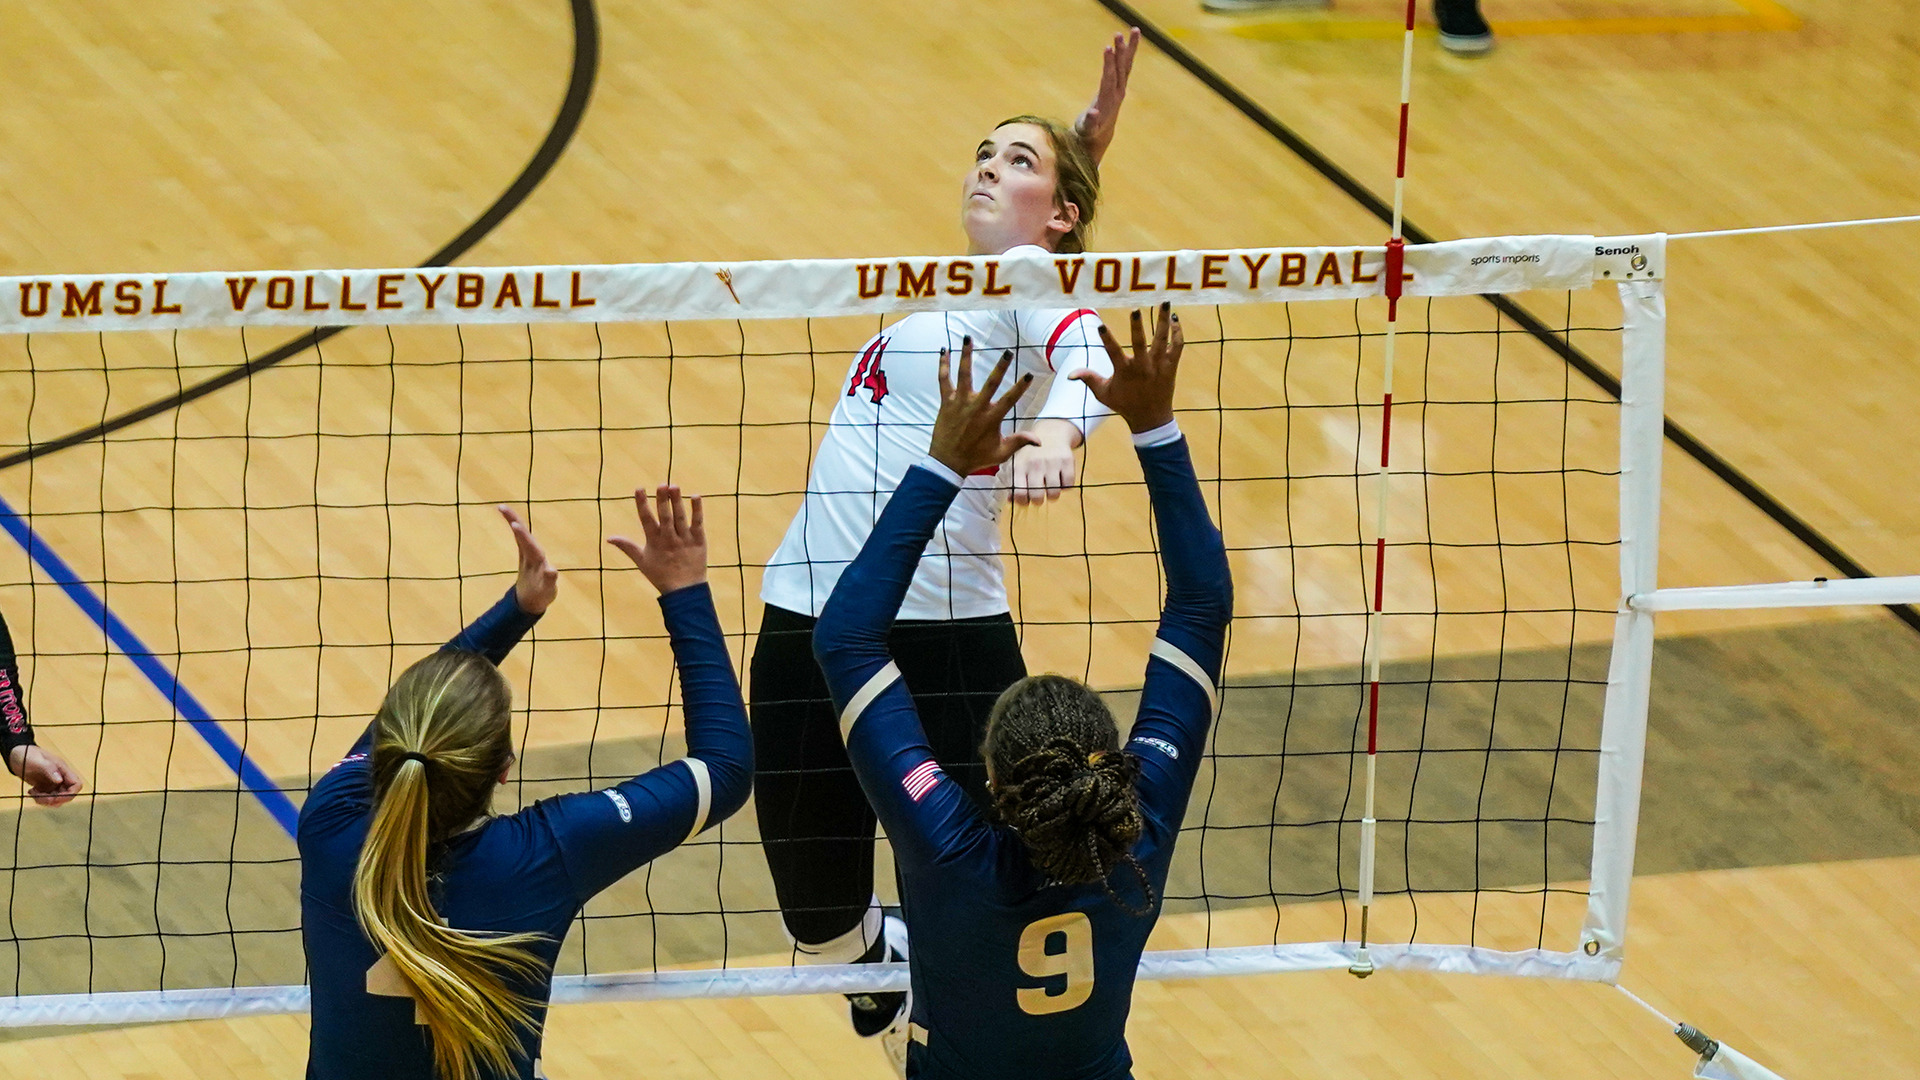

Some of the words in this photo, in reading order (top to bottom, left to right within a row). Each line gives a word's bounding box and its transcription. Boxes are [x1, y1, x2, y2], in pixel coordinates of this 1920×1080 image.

[856, 260, 1012, 300] UMSL
[1055, 250, 1415, 295] VOLLEYBAL
[1470, 254, 1501, 267] sports
[1501, 253, 1541, 266] imports
[1594, 244, 1640, 257] Senoh
[18, 280, 183, 319] UMSL
[226, 271, 597, 312] VOLLEYBALL
[847, 336, 892, 405] 14
[1016, 911, 1095, 1016] 9
